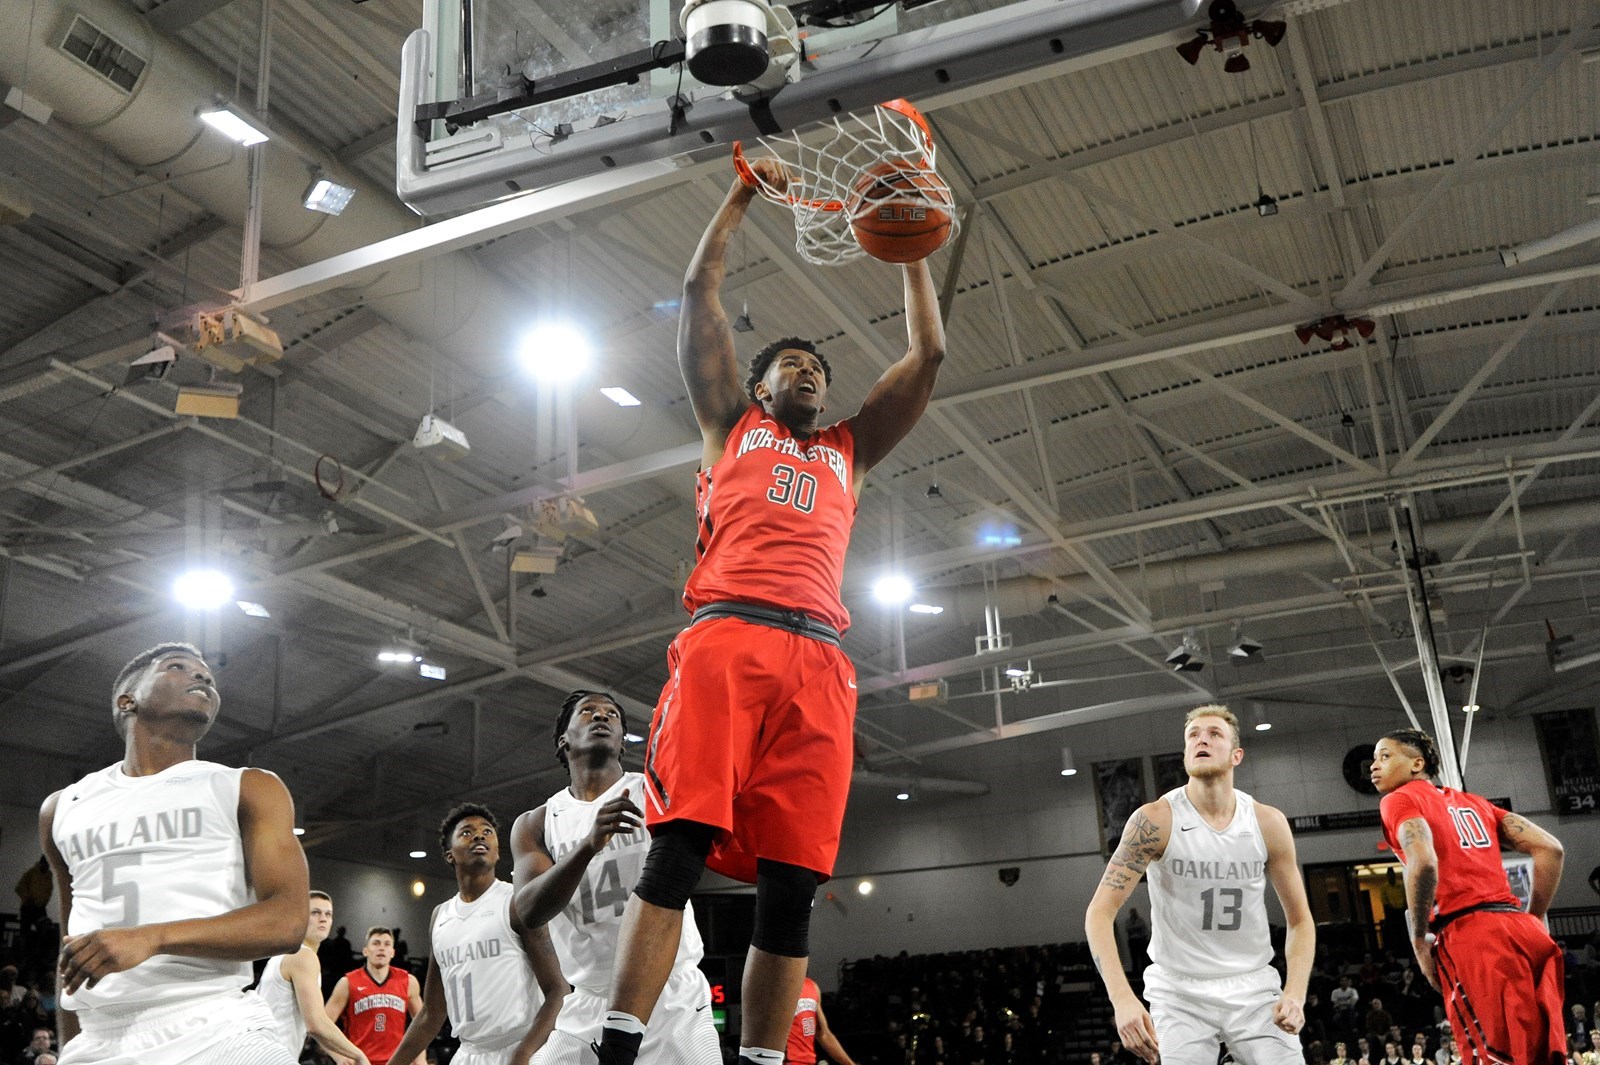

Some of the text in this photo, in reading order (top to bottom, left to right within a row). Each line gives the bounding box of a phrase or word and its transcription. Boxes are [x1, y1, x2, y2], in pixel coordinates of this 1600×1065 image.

[736, 428, 848, 495] NORTHEASTERN
[766, 463, 818, 515] 30
[1568, 794, 1596, 810] 34
[1447, 806, 1492, 849] 10
[101, 853, 140, 928] 5
[1171, 858, 1264, 880] OAKLAND
[579, 858, 629, 925] 14
[1200, 887, 1243, 931] 13
[438, 938, 500, 968] AKLAND
[448, 972, 475, 1023] 11
[711, 985, 725, 1003] 5
[374, 1013, 387, 1032] 2
